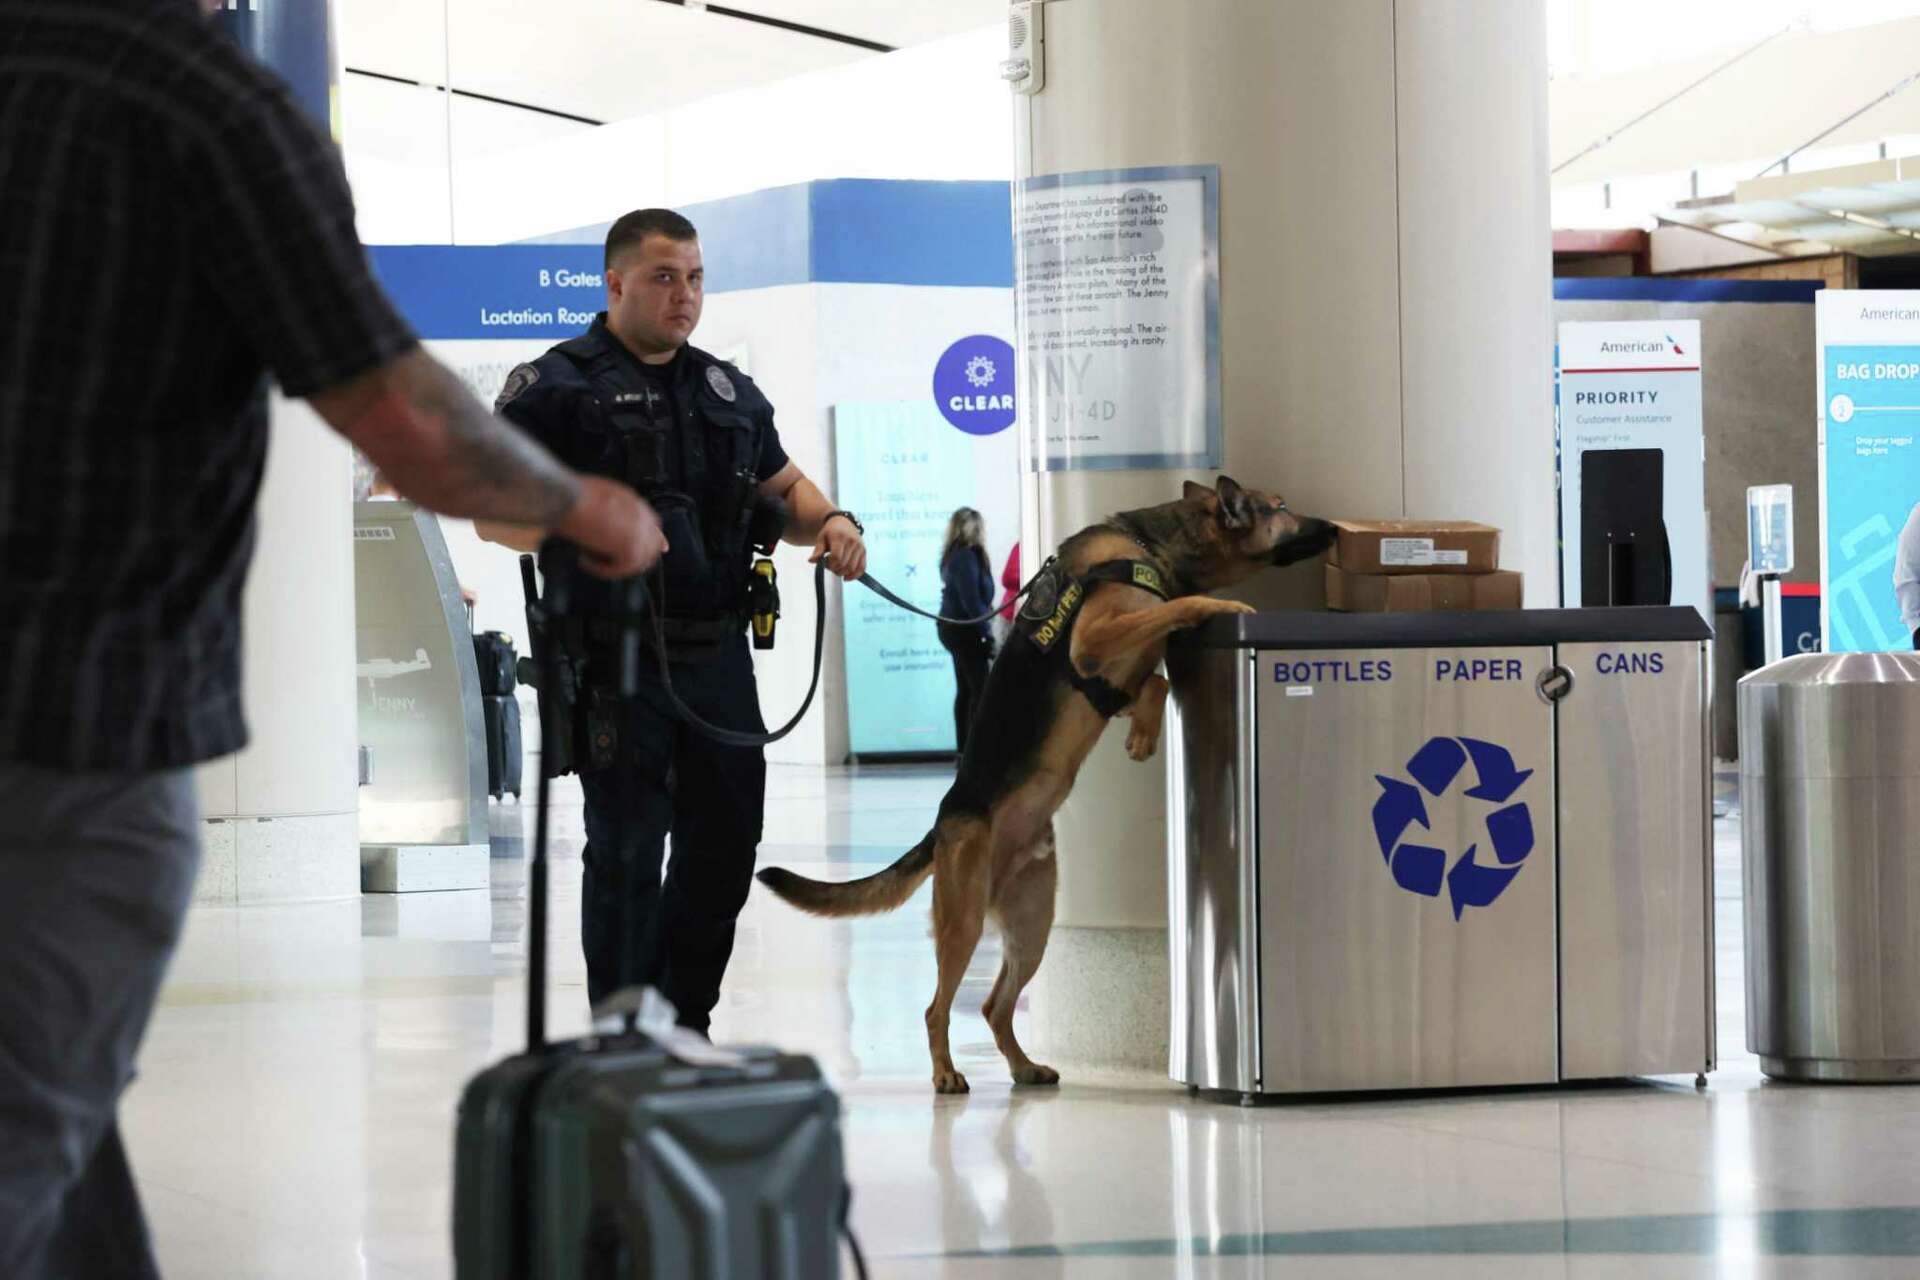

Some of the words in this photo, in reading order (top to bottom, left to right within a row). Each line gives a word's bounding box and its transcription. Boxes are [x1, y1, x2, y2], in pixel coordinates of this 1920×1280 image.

[1148, 192, 1163, 202] the
[1140, 216, 1164, 226] video
[1139, 251, 1157, 262] rich
[1139, 264, 1148, 274] of
[1149, 263, 1164, 274] the
[540, 269, 551, 287] B
[555, 269, 602, 287] Gates
[1140, 275, 1150, 286] of
[1152, 274, 1167, 285] the
[1127, 287, 1142, 298] The
[1144, 286, 1169, 299] Jenny
[481, 308, 553, 325] Lactation
[1861, 307, 1920, 320] American
[1137, 323, 1153, 334] The
[1600, 341, 1664, 353] American
[1837, 363, 1871, 380] BAG
[1874, 363, 1920, 380] DROP
[949, 394, 1014, 412] CLEAR
[1575, 391, 1659, 405] PRIORITY
[1575, 414, 1621, 425] Customer
[1623, 414, 1673, 424] Assistance
[880, 453, 929, 464] CLEAR
[1035, 626, 1054, 645] DO
[1273, 661, 1393, 683] BOTTLES
[1435, 659, 1523, 681] PAPER
[1596, 652, 1664, 675] CANS
